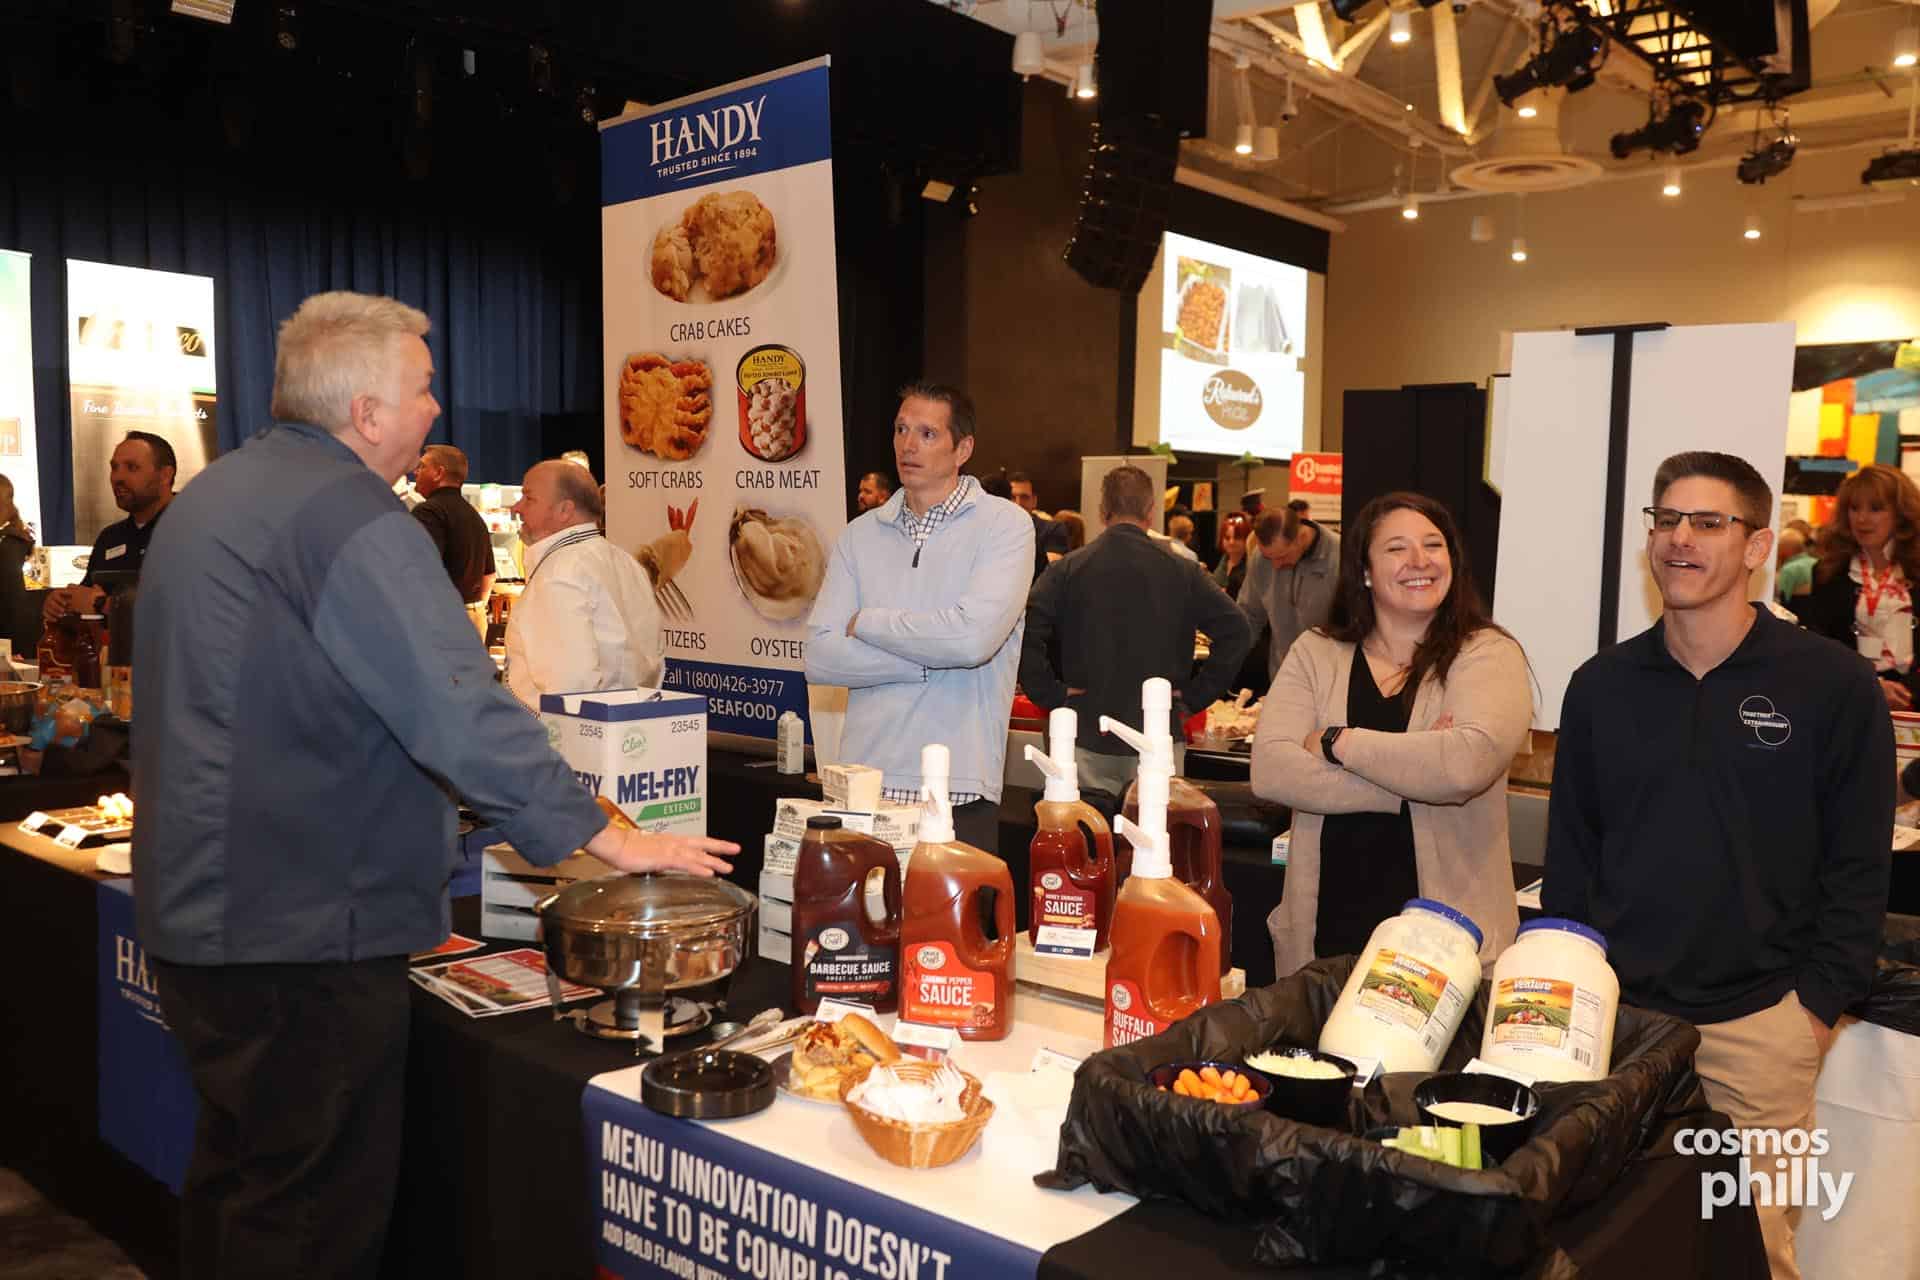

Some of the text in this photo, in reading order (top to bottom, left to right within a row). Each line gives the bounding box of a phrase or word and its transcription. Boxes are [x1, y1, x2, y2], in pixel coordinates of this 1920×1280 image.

[649, 94, 767, 166] HANDY
[657, 147, 757, 178] TRUSTED SINCE 1894
[670, 316, 751, 343] CRAB CAKES
[628, 471, 703, 489] SOFT CRABS
[735, 469, 821, 489] CRAB MEAT
[685, 671, 784, 697] 1(800)426-3977
[709, 697, 777, 721] SEAFOOD
[578, 723, 604, 739] 23545
[671, 719, 700, 734] 23545
[617, 765, 700, 805] MEL-FRY
[663, 802, 697, 816] EXTEND
[1044, 900, 1084, 916] SAUCE
[115, 935, 160, 996] HA
[810, 961, 891, 976] BARBECUE SAUCE
[948, 976, 973, 986] PEPPER
[919, 983, 973, 1007] SAUCE
[1113, 1009, 1154, 1037] BUFFALO
[1112, 1026, 1143, 1048] SAU
[602, 1120, 952, 1280] MENU INNOVATION DOESN'T
[602, 1169, 658, 1231] HAVE
[663, 1193, 693, 1247] TO
[699, 1211, 730, 1264] BE
[602, 1220, 624, 1248] ADD
[624, 1230, 653, 1262] BOLD
[653, 1243, 695, 1280] FLAVOR
